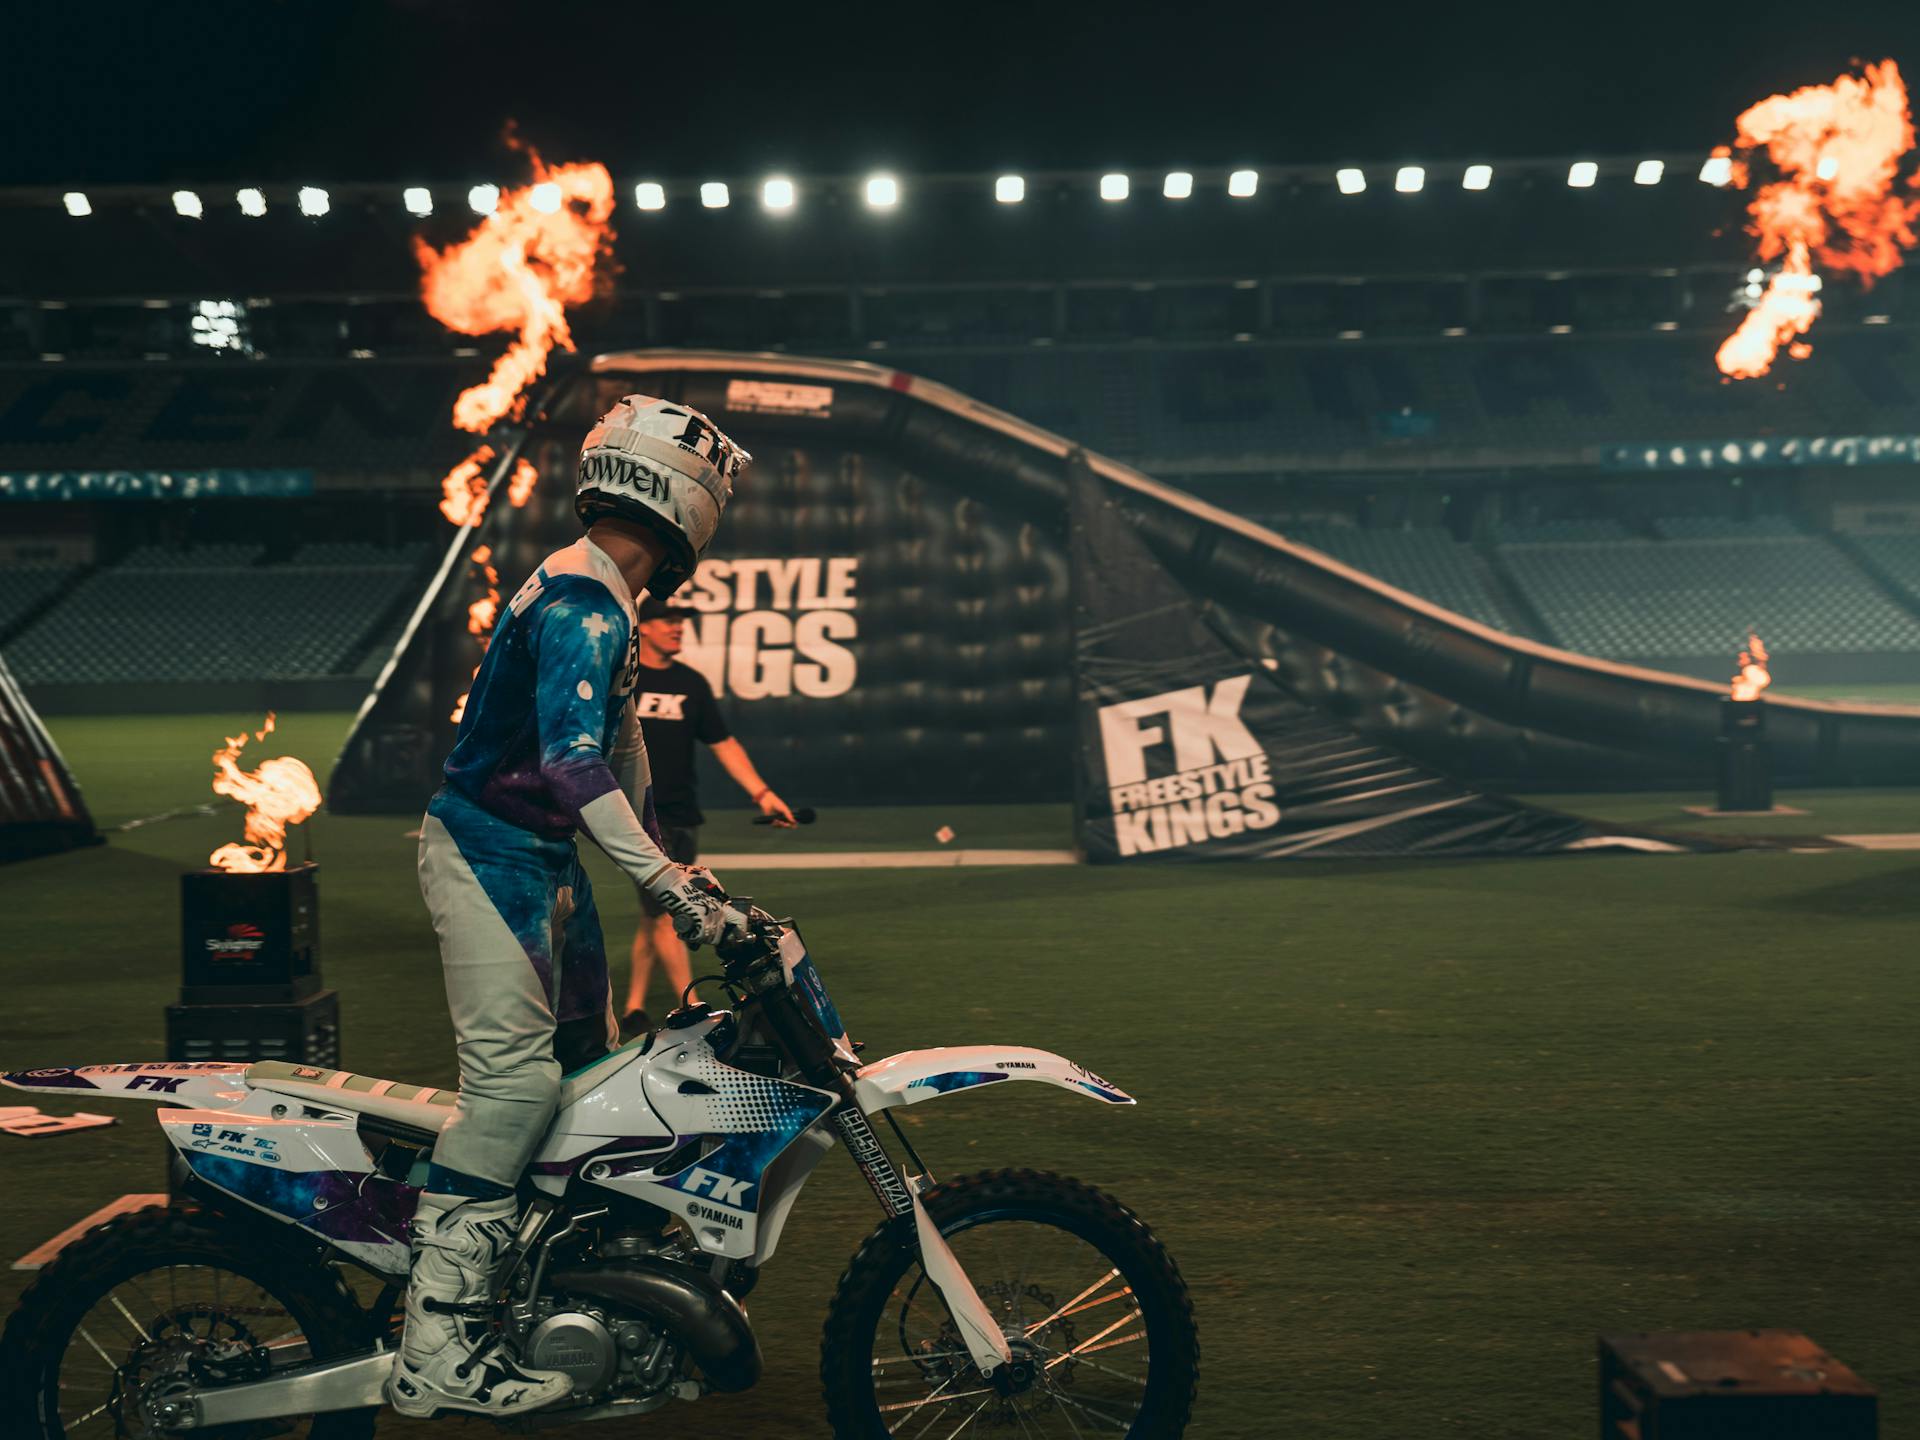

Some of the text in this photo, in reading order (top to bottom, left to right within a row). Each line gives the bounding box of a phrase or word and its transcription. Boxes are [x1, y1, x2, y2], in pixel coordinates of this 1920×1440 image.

[636, 692, 688, 720] FK
[1098, 673, 1266, 789] FK
[1110, 753, 1273, 813] FREESTYLE
[1114, 782, 1281, 857] KINGS
[124, 1075, 189, 1093] FK
[217, 1130, 247, 1143] FK
[682, 1167, 755, 1207] FK
[701, 1206, 743, 1230] YAMAHA
